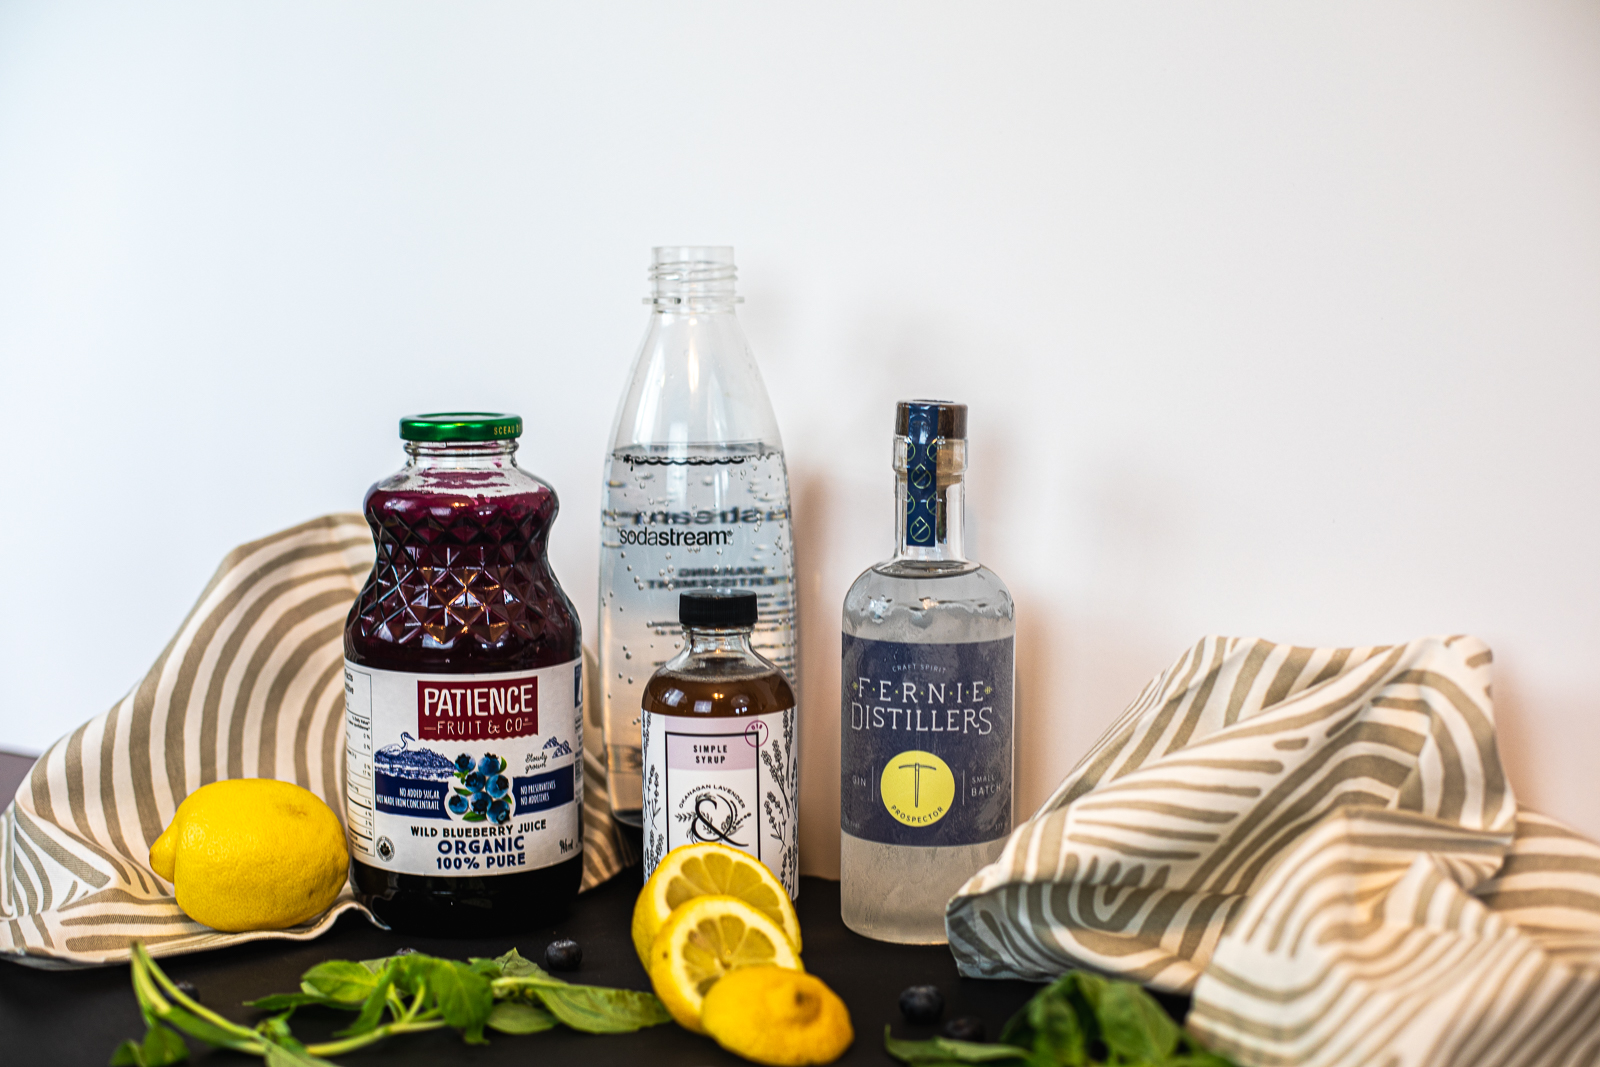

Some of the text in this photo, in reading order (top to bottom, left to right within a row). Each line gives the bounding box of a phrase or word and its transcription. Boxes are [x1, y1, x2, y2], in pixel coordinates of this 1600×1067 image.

[493, 425, 515, 436] SCEAU
[619, 527, 728, 546] sodastream
[892, 663, 947, 674] CRAFT SPIRIT
[424, 684, 534, 717] PATIENCE
[851, 702, 993, 735] DISTILLERS
[437, 720, 482, 735] FRUIT
[487, 719, 500, 734] &
[693, 744, 728, 753] SIMPLE
[525, 751, 548, 764] Slowly
[695, 755, 726, 764] SYRUP
[525, 762, 547, 774] grown
[852, 775, 867, 787] GIN
[971, 775, 996, 784] SMALL
[399, 787, 407, 797] NO
[423, 789, 440, 800] SUGAR
[520, 785, 528, 795] NO
[679, 784, 746, 809] OKANAGAN LAVENDER
[971, 784, 1001, 797] BATCH
[520, 796, 528, 806] NO
[890, 804, 944, 823] PROSPECTOR
[410, 819, 547, 838] WILD BLUEBERRY JUICE
[437, 835, 525, 855] ORGANIC
[436, 853, 526, 870] 100% PURE
